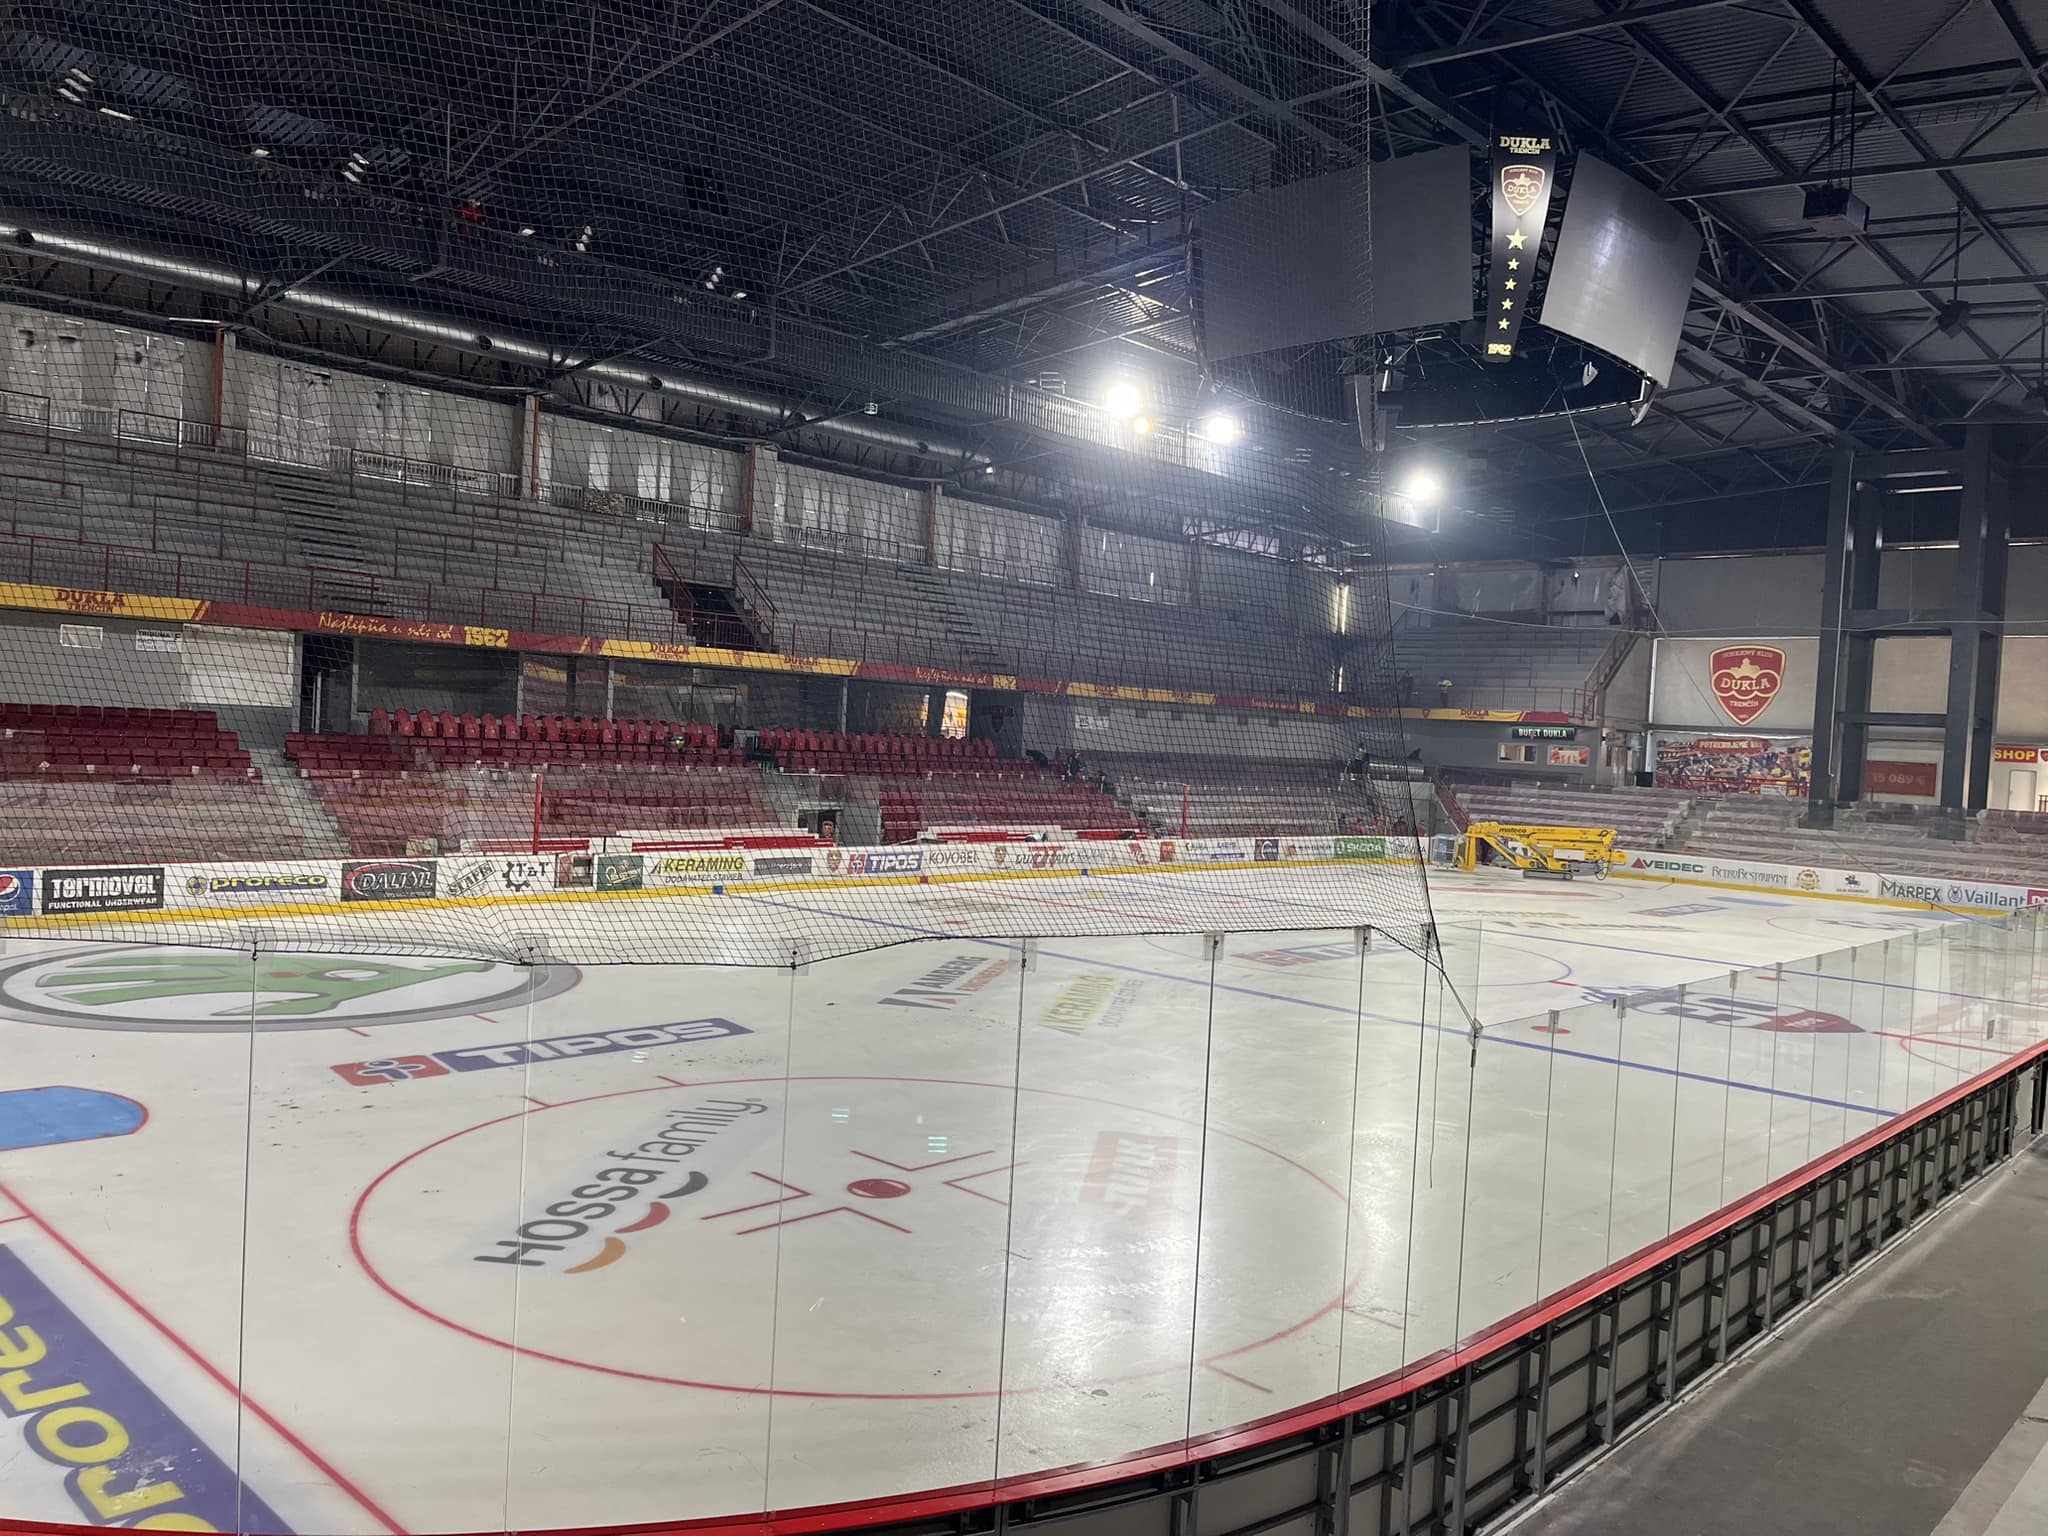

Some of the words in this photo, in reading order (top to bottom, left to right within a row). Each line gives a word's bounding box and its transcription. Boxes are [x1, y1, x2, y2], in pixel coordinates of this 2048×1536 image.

[1500, 136, 1551, 150] DUKLA
[56, 589, 126, 607] DUKLA
[651, 642, 690, 656] DUKLA
[1720, 677, 1771, 691] DUKLA
[1460, 708, 1489, 717] DUKLA
[1543, 729, 1567, 738] DUKLA
[1993, 748, 2036, 761] SHOP
[665, 856, 746, 873] KERAMING
[869, 854, 920, 872] TIPOS
[1643, 859, 1704, 874] VEIDEC
[212, 875, 327, 891] proreco
[1880, 880, 1941, 902] MARPEX
[48, 899, 102, 910] FUNCTIONAL
[1964, 889, 2026, 909] Vaillant
[911, 955, 989, 989] AMBERG
[455, 1021, 733, 1065] TIPOS
[473, 1167, 665, 1267] Hossa
[606, 1099, 769, 1163] family
